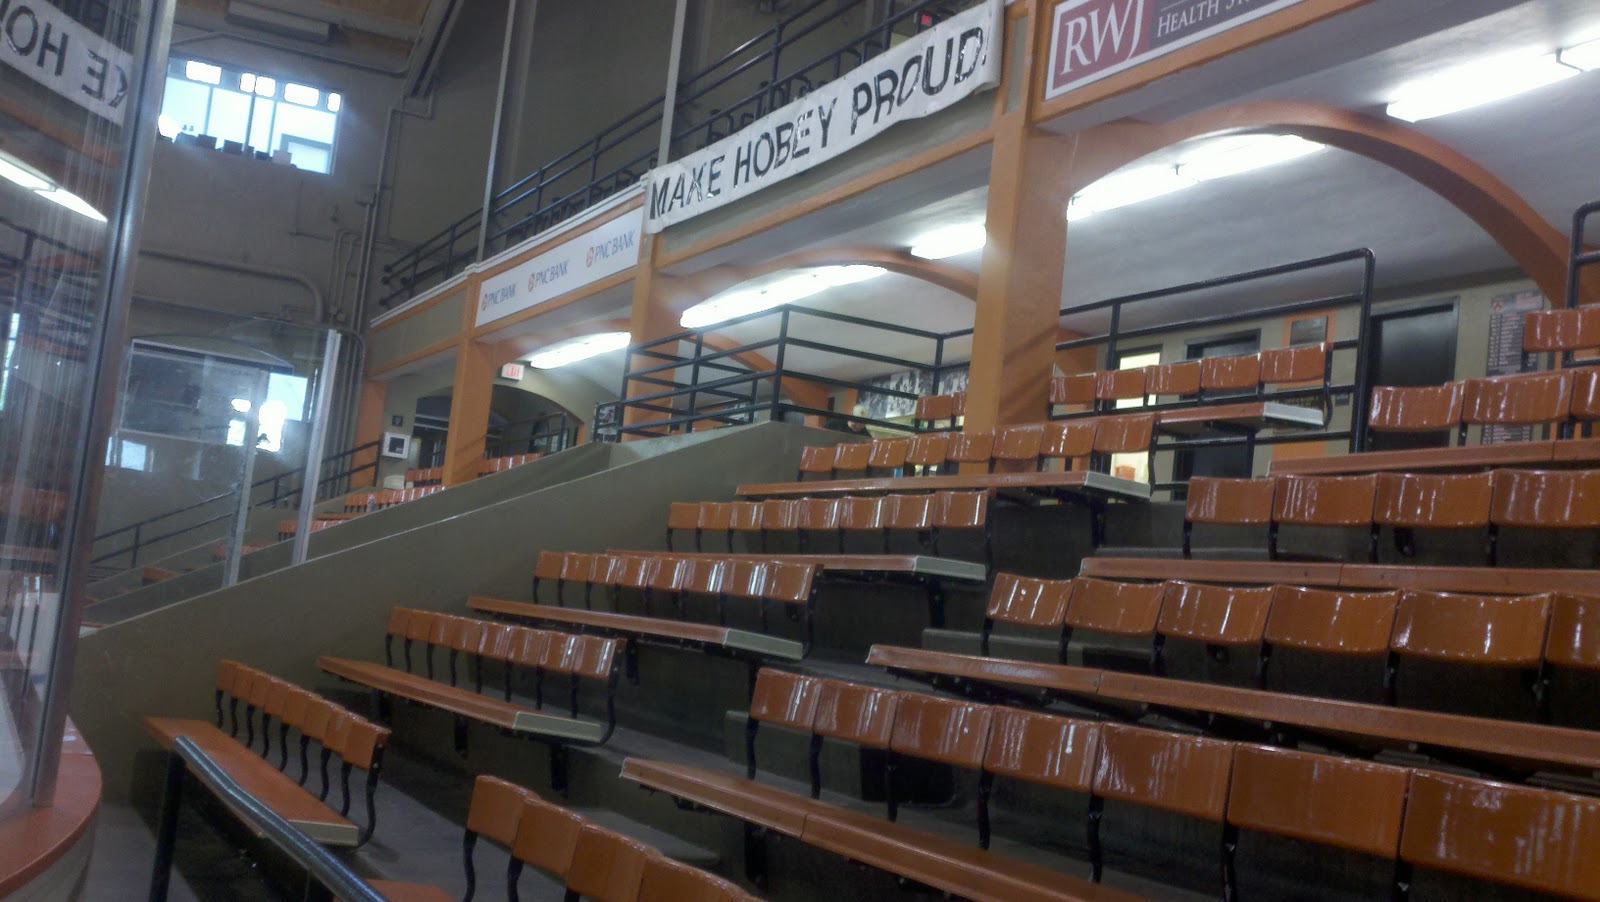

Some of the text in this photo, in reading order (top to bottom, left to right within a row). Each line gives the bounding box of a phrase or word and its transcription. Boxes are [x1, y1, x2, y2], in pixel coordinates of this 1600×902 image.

[1157, 0, 1218, 37] HEALTH
[650, 155, 725, 219] MAKE
[734, 97, 837, 188] HOBEY
[594, 230, 635, 262] PNC BANK
[535, 259, 570, 287] PNC BANK
